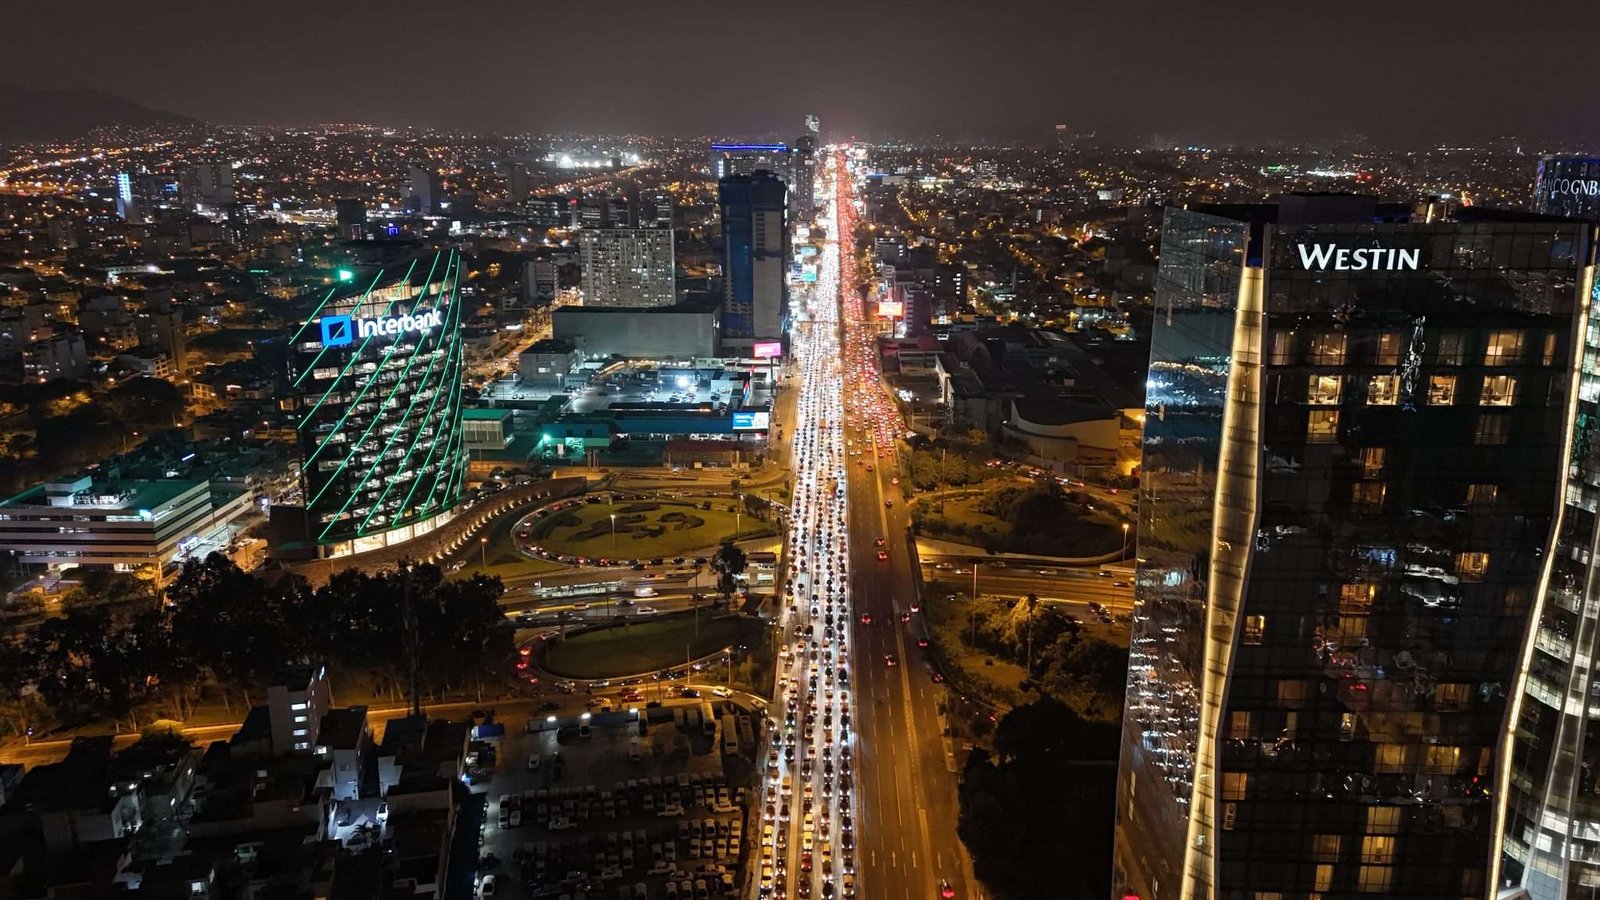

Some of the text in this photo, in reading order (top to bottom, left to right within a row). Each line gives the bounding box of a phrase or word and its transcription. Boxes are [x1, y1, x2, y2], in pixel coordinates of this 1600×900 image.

[1537, 177, 1598, 196] ANCO GNB
[1297, 243, 1420, 270] WESTIN
[357, 308, 442, 338] Interbank
